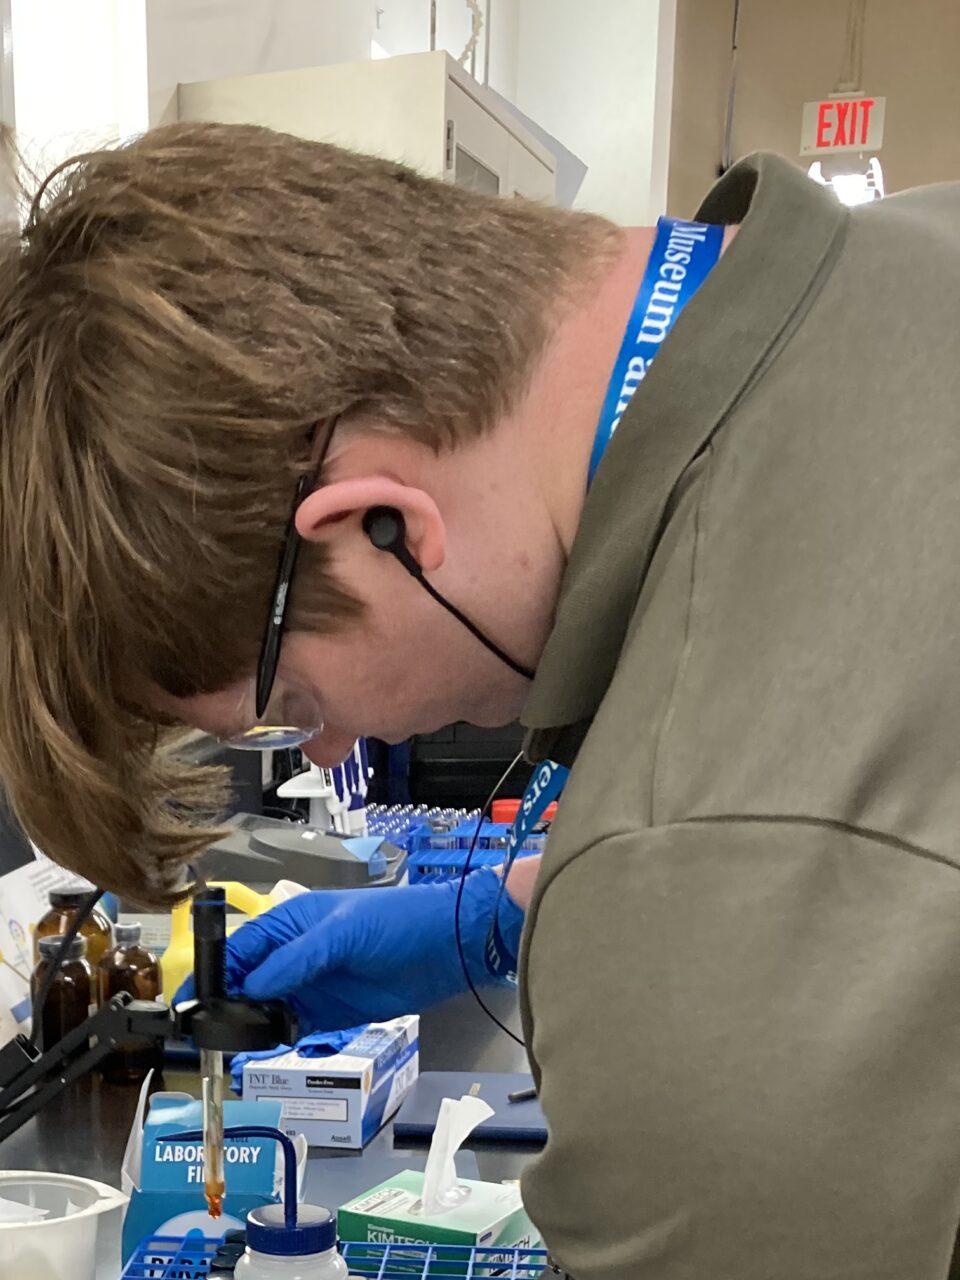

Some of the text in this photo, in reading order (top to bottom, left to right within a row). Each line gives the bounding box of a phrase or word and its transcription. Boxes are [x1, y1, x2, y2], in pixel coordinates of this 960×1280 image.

[816, 100, 875, 148] EXIT
[635, 222, 710, 345] Museum
[155, 1145, 261, 1163] LABORORY
